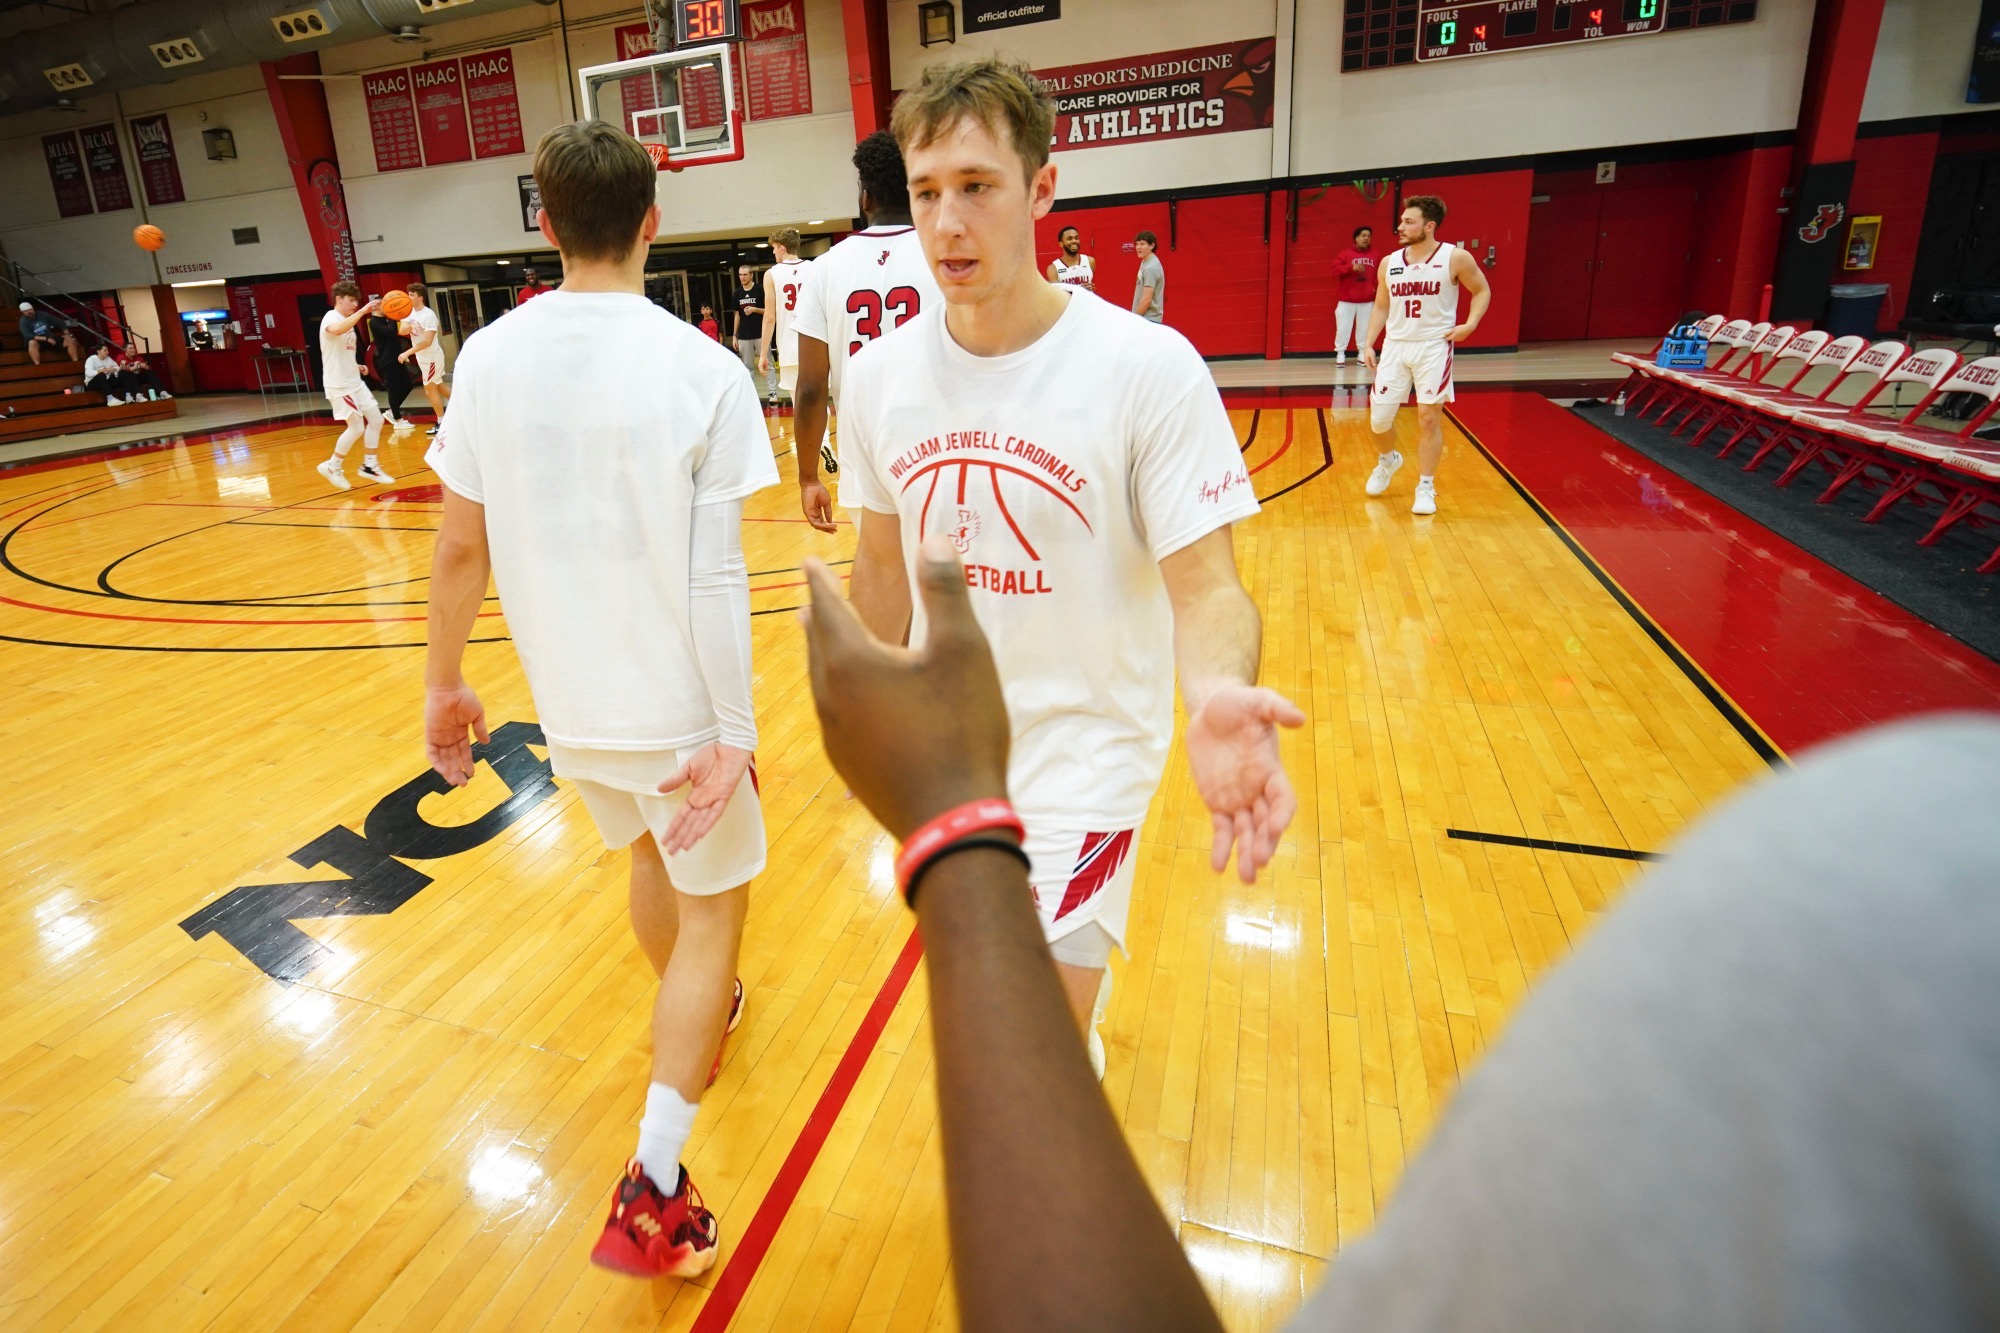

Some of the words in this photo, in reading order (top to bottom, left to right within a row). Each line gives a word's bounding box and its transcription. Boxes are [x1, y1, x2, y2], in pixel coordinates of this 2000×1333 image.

[977, 10, 1008, 23] official
[1008, 5, 1045, 18] outfitter
[1427, 9, 1459, 23] FOULS
[1498, 0, 1538, 13] PLAYER
[1589, 8, 1603, 25] 4
[686, 1, 724, 39] 30
[749, 2, 796, 40] NAIA
[1626, 20, 1651, 32] WON
[1440, 21, 1456, 45] 0
[1474, 24, 1486, 40] 4
[1583, 26, 1605, 38] TOL
[623, 30, 657, 60] NAI
[1428, 46, 1450, 58] WON
[1468, 41, 1489, 53] TOL
[415, 66, 457, 89] HAAC
[465, 56, 509, 79] HAAC
[1041, 77, 1071, 93] TAL
[1073, 67, 1138, 89] SPORTS
[1140, 53, 1233, 80] MEDICINE
[366, 75, 407, 97] HAAC
[1098, 86, 1168, 107] PROVIDER
[1171, 82, 1201, 97] FOR
[1068, 98, 1224, 143] ATHLETICS
[165, 262, 213, 275] CONCESSIONS
[333, 241, 347, 281] VENT
[340, 229, 356, 286] TRANCE
[783, 283, 802, 311] 3
[1391, 281, 1441, 297] CARDINALS
[1405, 299, 1422, 319] 12
[1821, 344, 1853, 359] JEWELL
[1858, 350, 1893, 367] JEWELL
[1901, 357, 1943, 376] JEWELL
[1956, 364, 2000, 386] JEWELL
[888, 436, 942, 480] WILLIAM
[945, 431, 1000, 452] JEWELL
[1004, 436, 1088, 494] CARDINALS
[963, 564, 1053, 595] ETBALL
